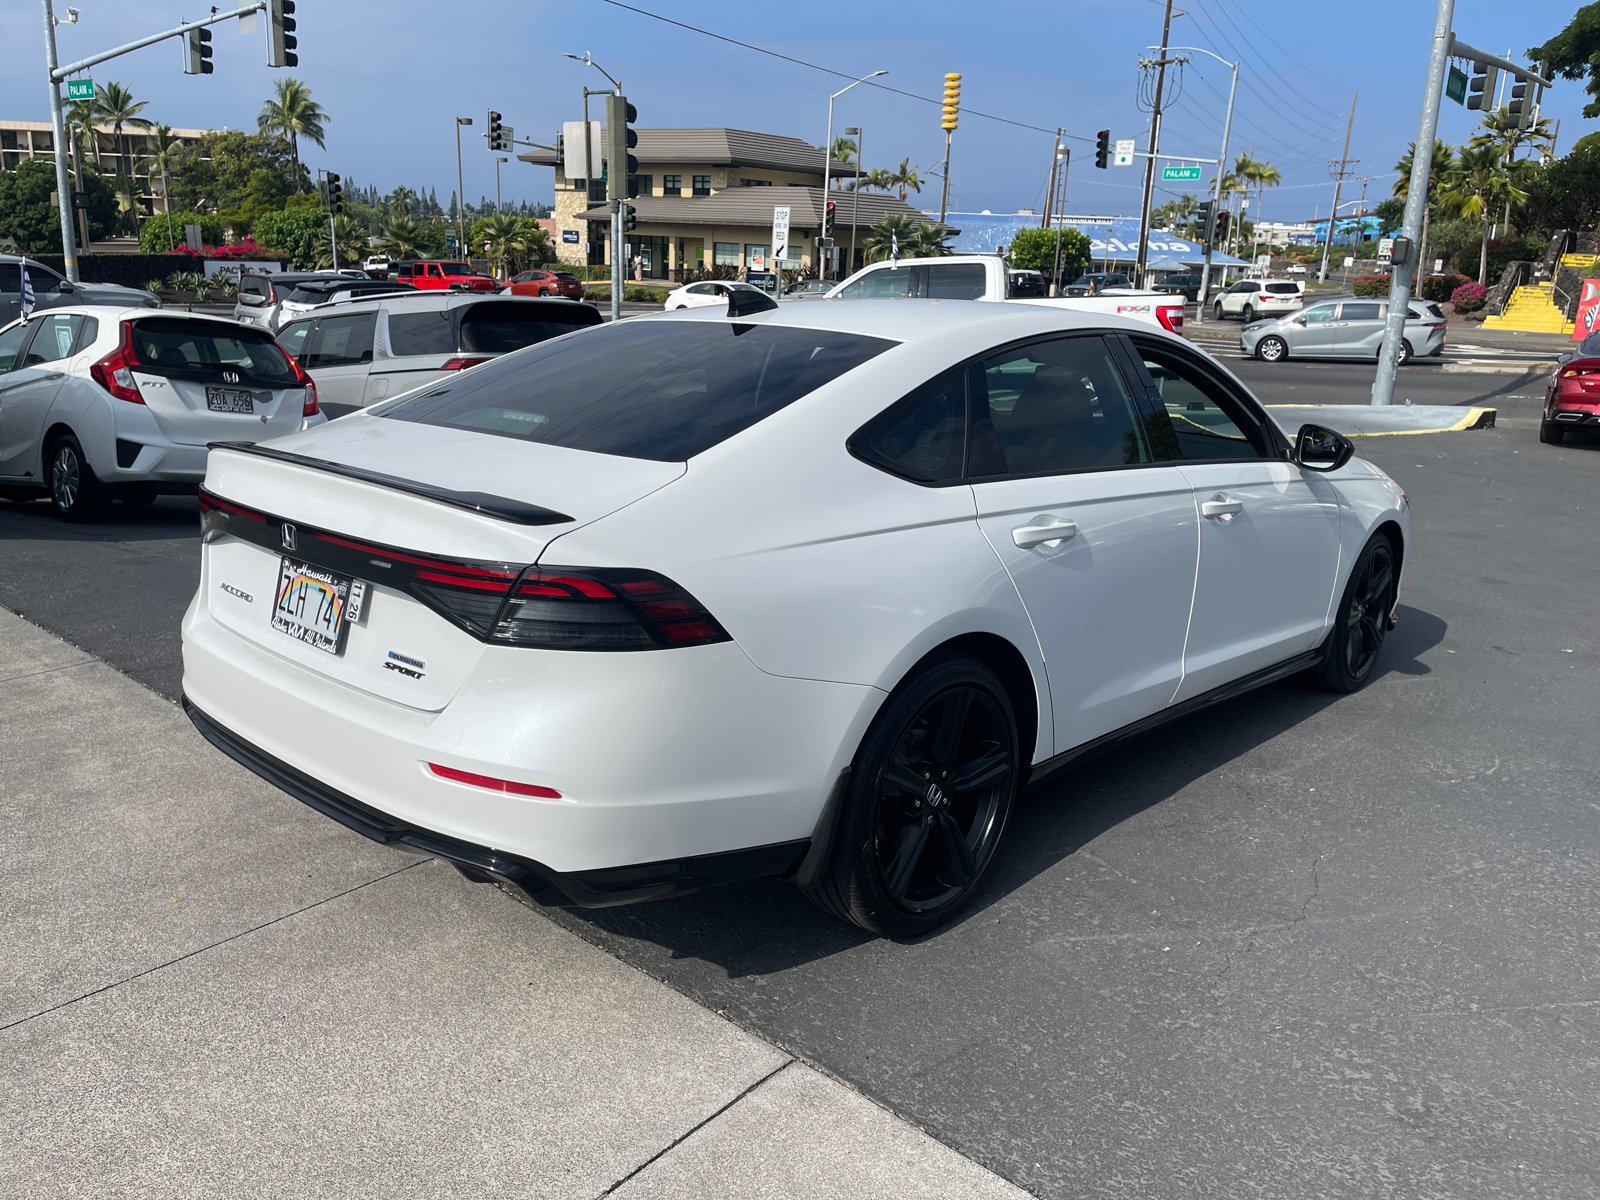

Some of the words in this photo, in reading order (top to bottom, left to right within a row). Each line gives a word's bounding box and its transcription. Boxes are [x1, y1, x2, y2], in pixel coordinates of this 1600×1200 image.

[70, 85, 87, 95] PALANI
[776, 211, 788, 220] STOP
[776, 231, 785, 241] RED
[1090, 238, 1191, 252] Aloha
[220, 266, 254, 275] PACIC
[1117, 305, 1150, 313] FX4
[209, 393, 228, 406] ZDA
[233, 395, 251, 407] 656
[296, 564, 332, 584] Hawaii
[220, 582, 254, 603] ACCORD
[278, 574, 309, 619] ZLH
[316, 588, 343, 633] 747
[271, 616, 287, 632] Aloha
[304, 630, 315, 644] All
[314, 633, 337, 654] Islands
[382, 661, 426, 680] SPORT
